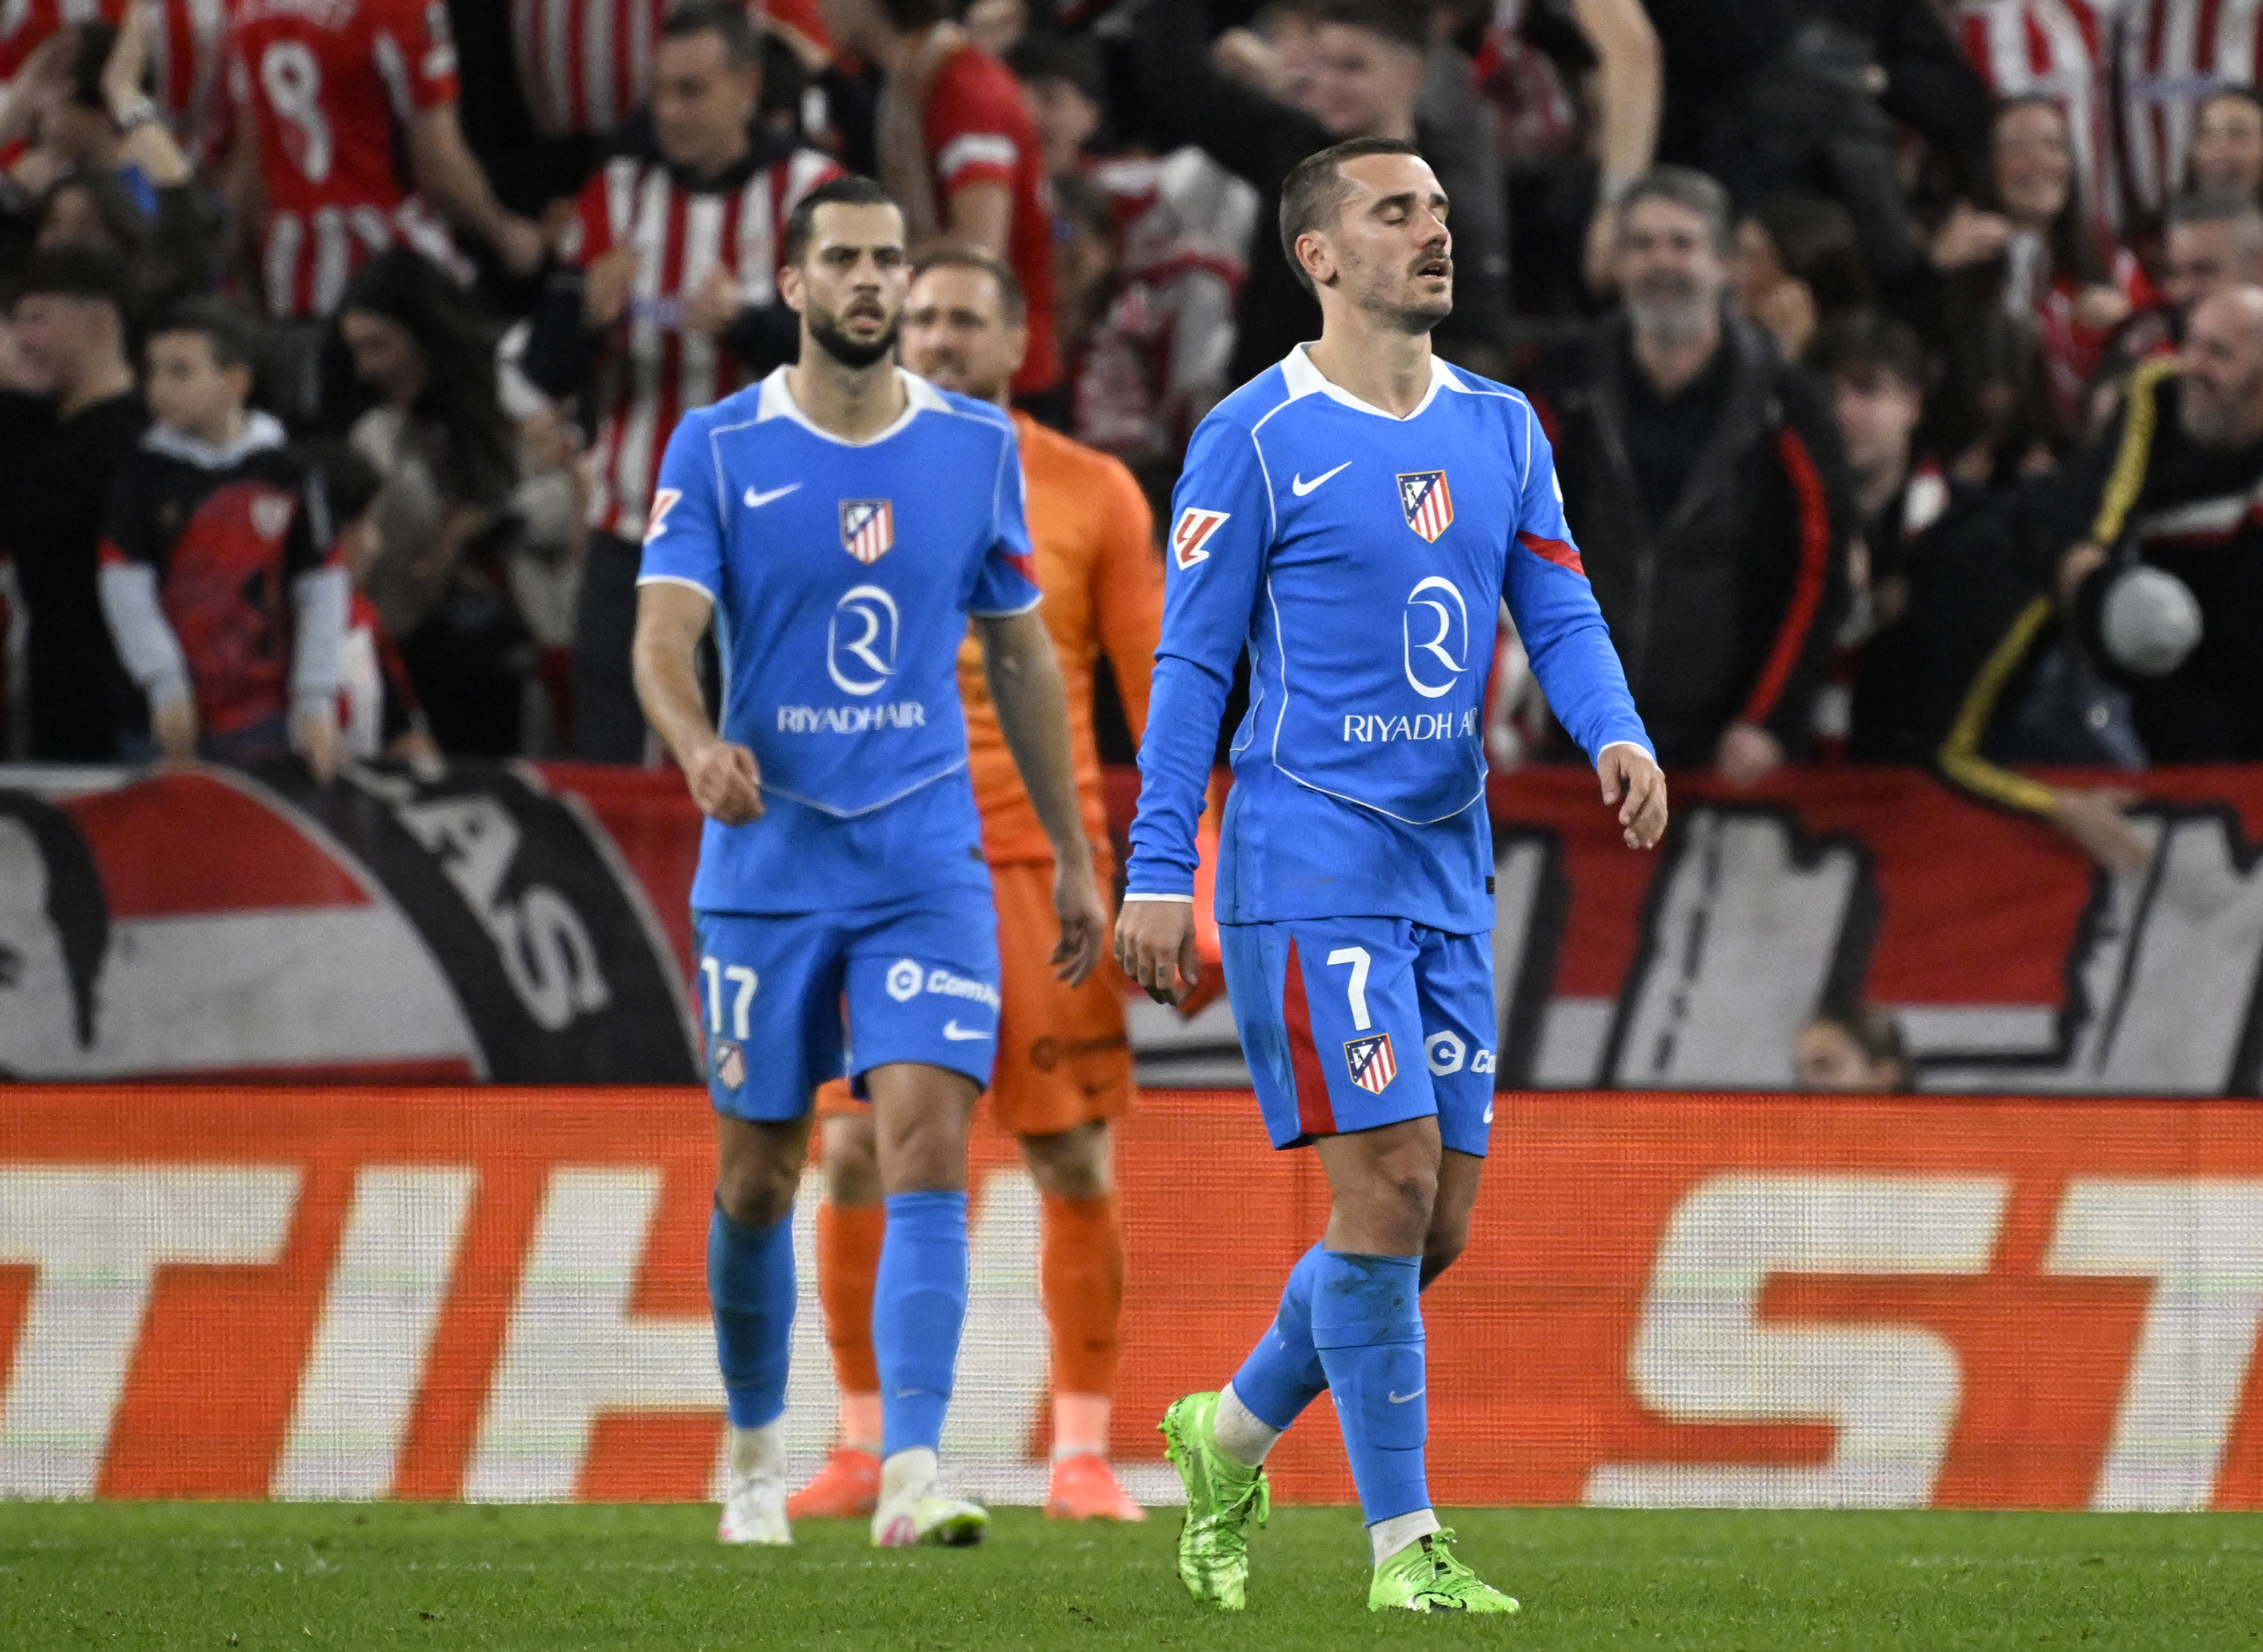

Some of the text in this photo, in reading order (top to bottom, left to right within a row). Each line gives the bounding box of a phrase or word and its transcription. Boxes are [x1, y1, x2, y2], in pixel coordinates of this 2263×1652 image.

[1344, 712, 1452, 742] RIYADH
[701, 956, 759, 1041] 17
[1326, 946, 1371, 1031] 7
[1581, 1170, 2263, 1512] ST
